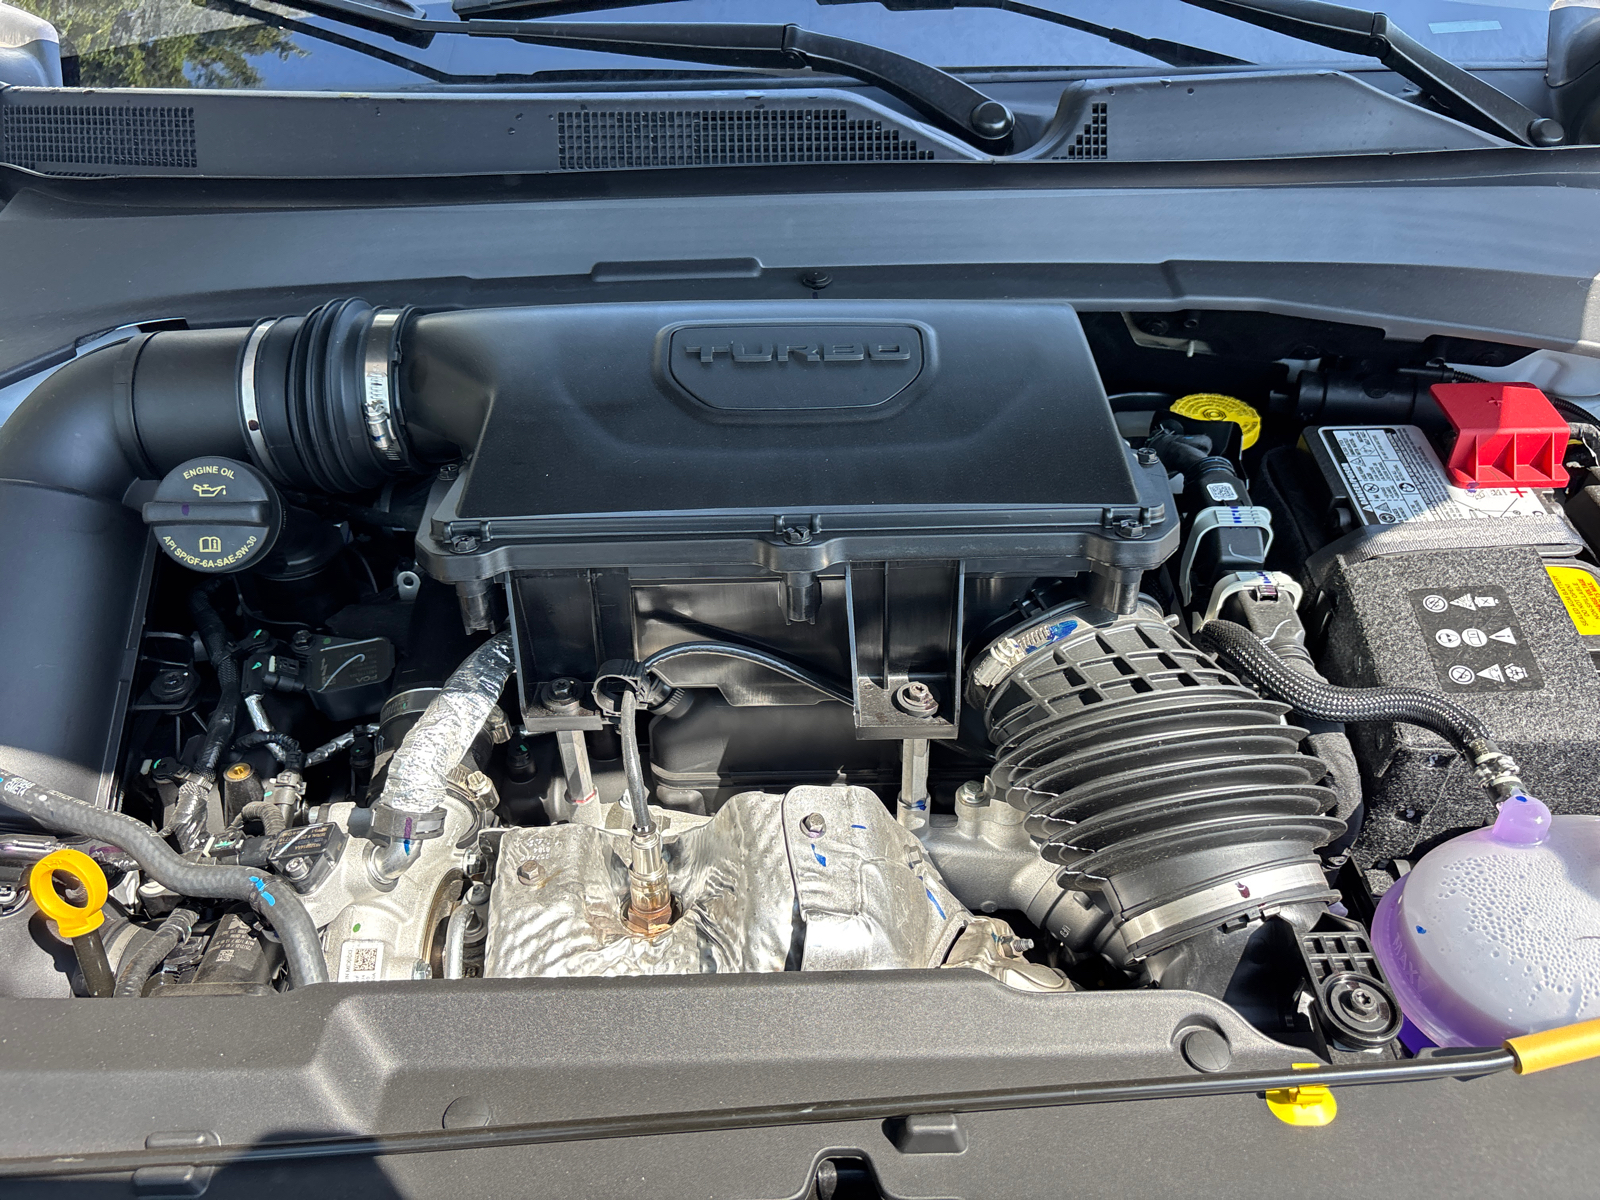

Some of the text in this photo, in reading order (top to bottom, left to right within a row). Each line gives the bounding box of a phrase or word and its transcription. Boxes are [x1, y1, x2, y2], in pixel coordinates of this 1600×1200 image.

[686, 342, 911, 362] TURBO
[183, 466, 235, 480] ENGINE OIL
[162, 536, 177, 550] API
[1392, 931, 1419, 985] MAX
